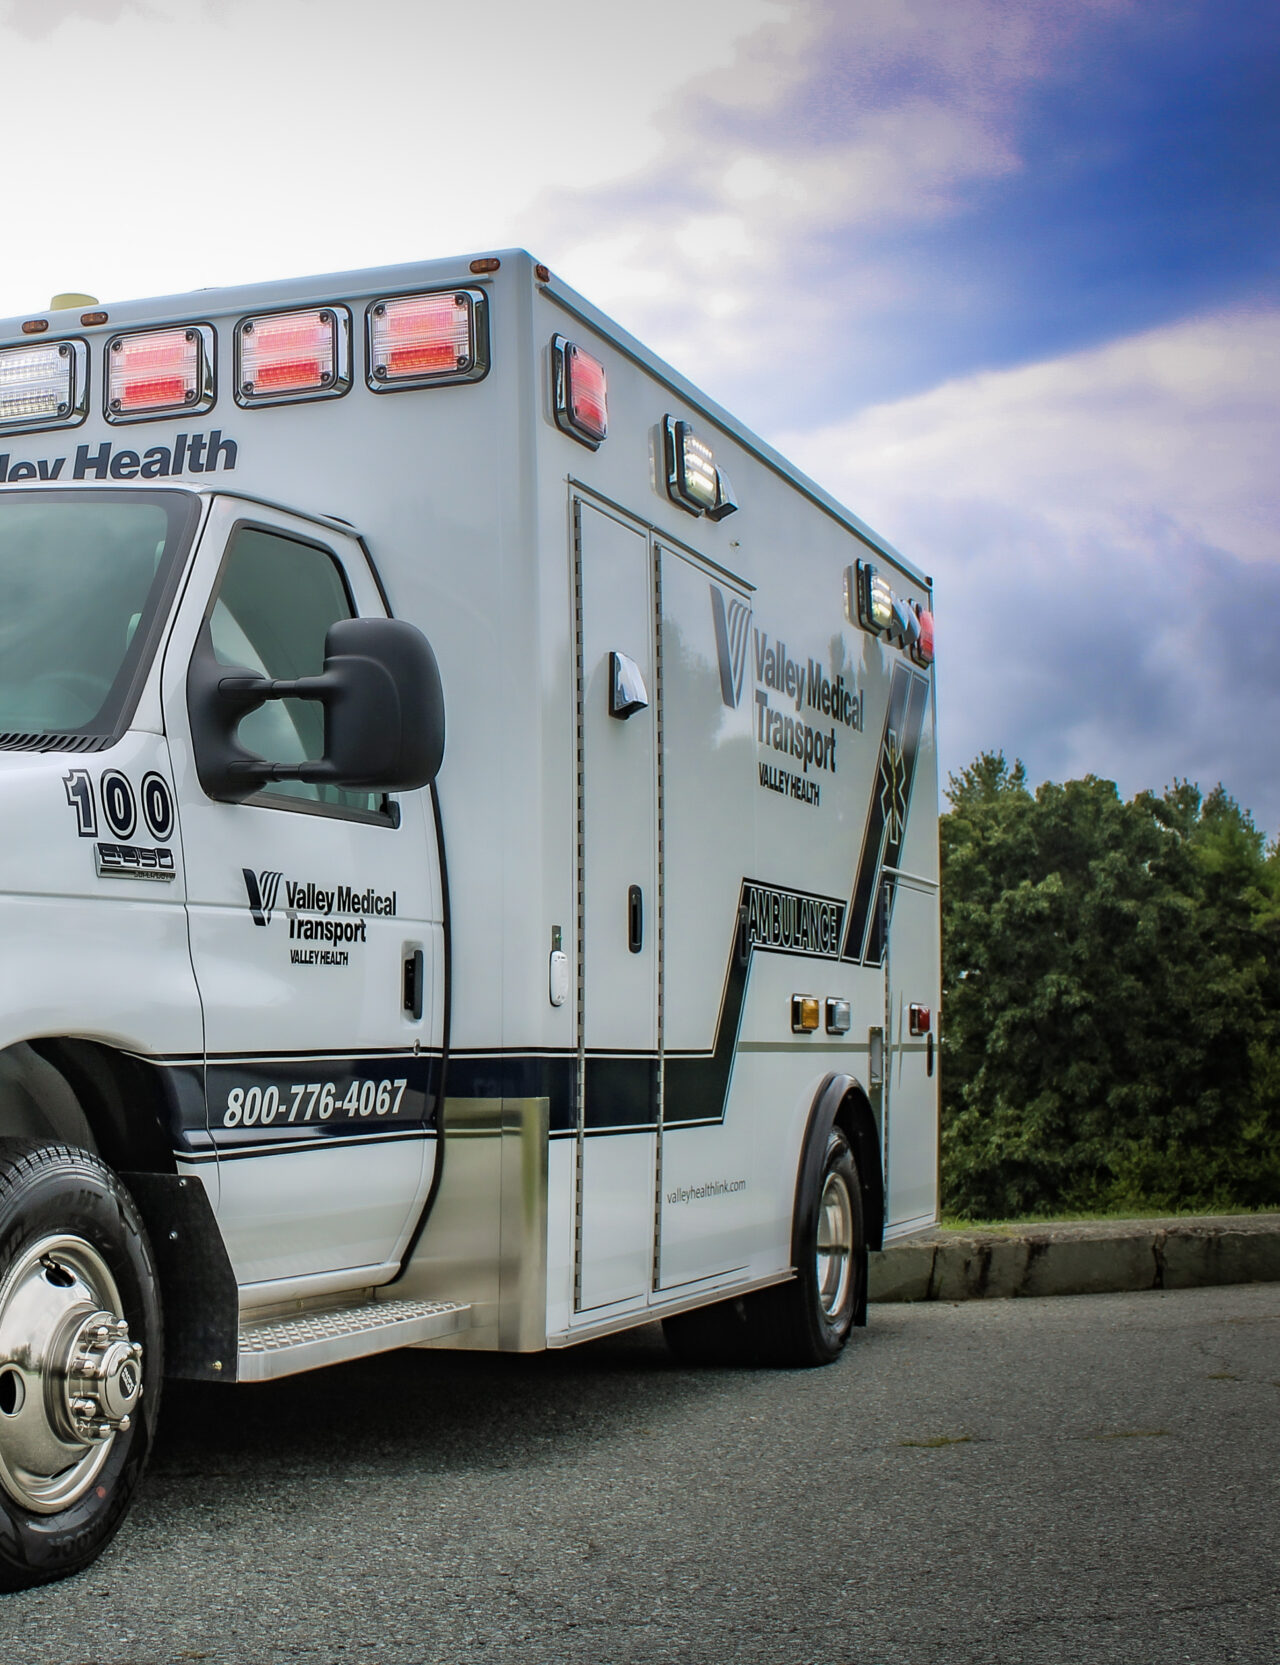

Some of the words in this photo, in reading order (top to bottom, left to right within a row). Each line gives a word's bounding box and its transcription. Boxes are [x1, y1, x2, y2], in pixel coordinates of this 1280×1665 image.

[73, 430, 238, 480] Health
[754, 628, 806, 712] Valley
[806, 658, 864, 733] Medical
[756, 689, 836, 773] Transport
[62, 768, 175, 842] 100
[759, 761, 790, 796] VALLEY
[790, 774, 820, 807] HEALTH
[285, 880, 335, 916] Valley
[337, 885, 396, 916] Medical
[748, 887, 838, 954] AMBULANCE
[286, 911, 367, 948] Transport
[290, 949, 319, 964] VALLEY
[320, 950, 348, 966] HEALTH
[223, 1079, 408, 1128] 800-776-4067
[667, 1179, 746, 1204] valleyhealthlink.com
